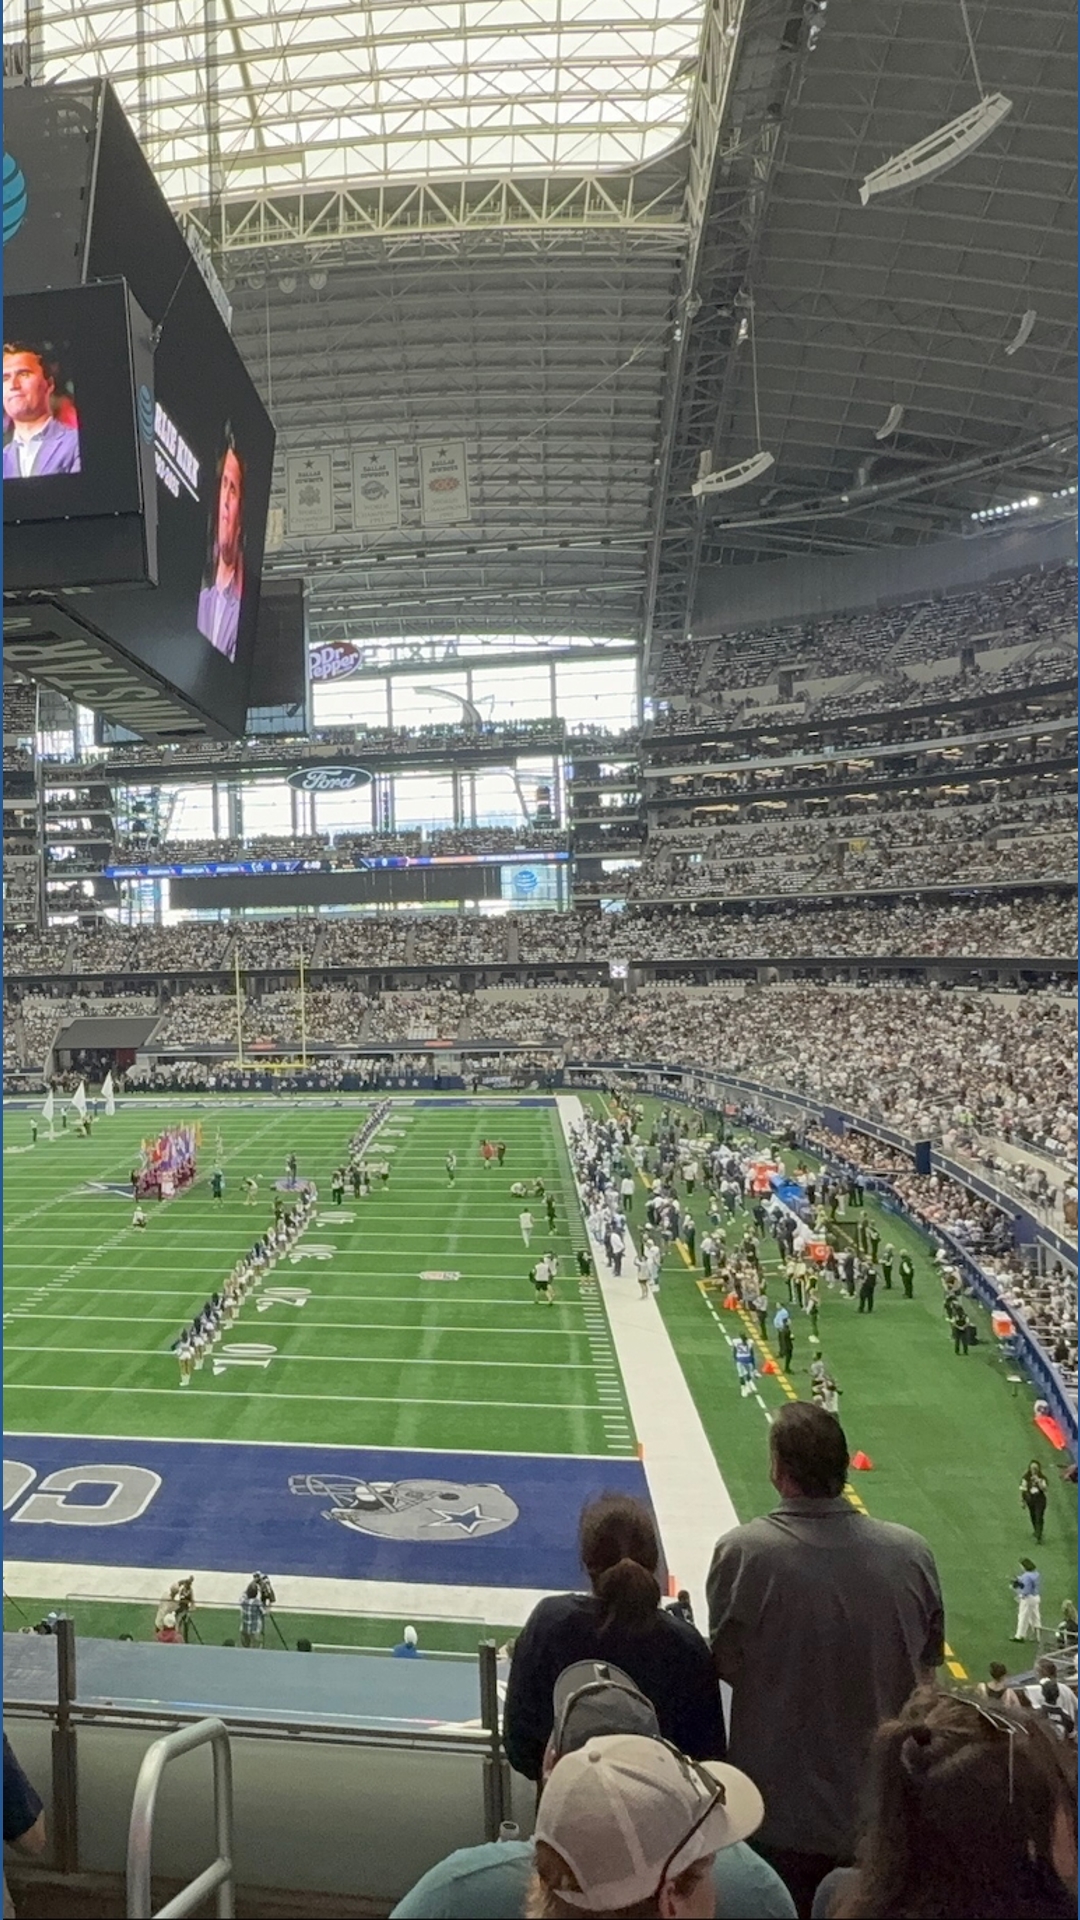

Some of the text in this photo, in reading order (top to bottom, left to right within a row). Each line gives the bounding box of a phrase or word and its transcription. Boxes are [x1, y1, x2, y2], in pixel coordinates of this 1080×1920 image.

[309, 652, 358, 680] Pepper
[321, 646, 344, 664] Dr
[3, 640, 207, 733] WINSTAR
[302, 769, 357, 789] Ford
[256, 1287, 312, 1307] 20
[213, 1343, 277, 1368] 10
